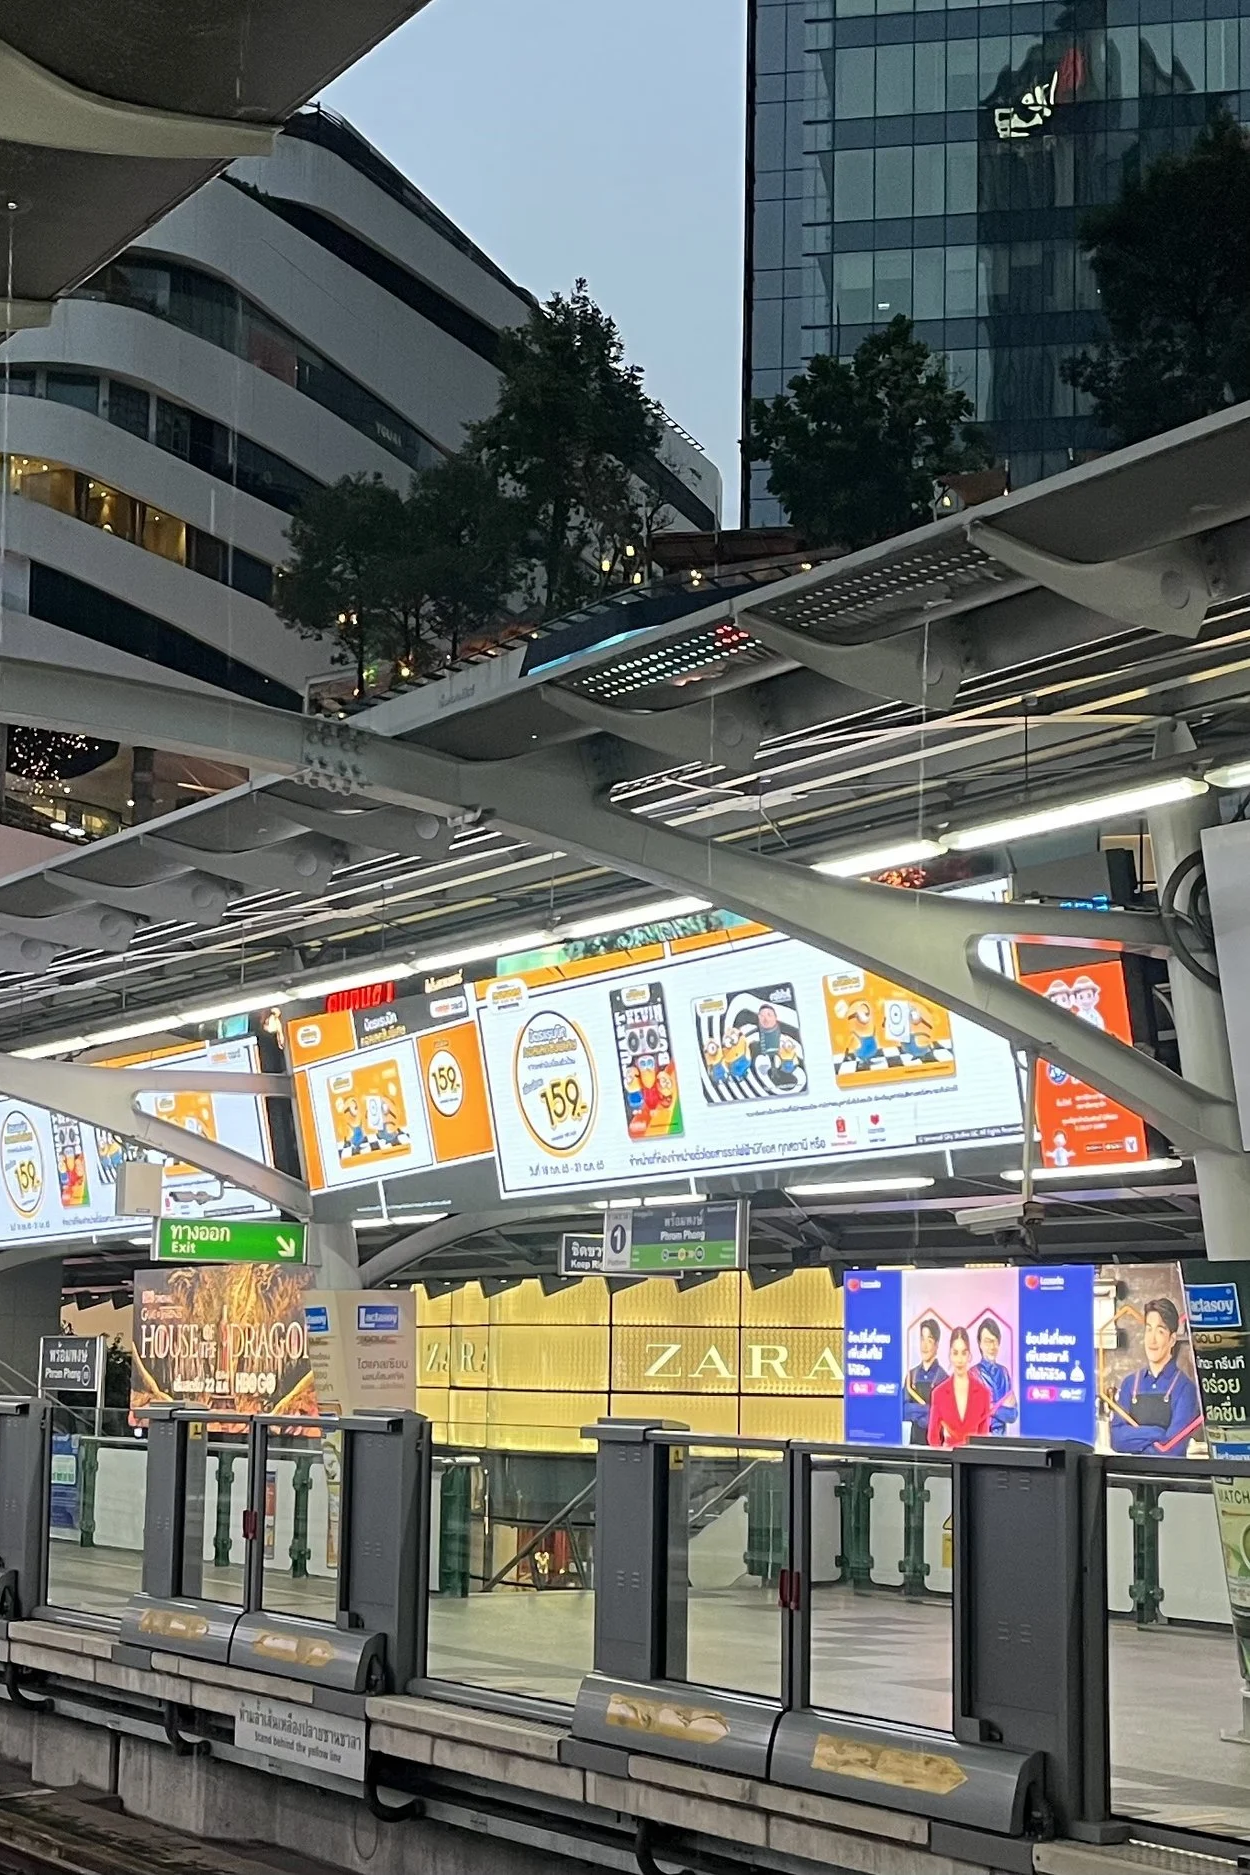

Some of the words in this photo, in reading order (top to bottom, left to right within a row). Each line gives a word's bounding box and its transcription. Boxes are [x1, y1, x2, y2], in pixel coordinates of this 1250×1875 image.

[170, 1223, 230, 1242] ทางออก
[613, 1226, 622, 1251] 1
[660, 1231, 682, 1241] Phrom
[683, 1230, 705, 1241] Phong
[171, 1242, 196, 1254] Exit
[141, 1325, 199, 1358] HOUSE
[203, 1325, 215, 1340] OF
[644, 1344, 845, 1380] ZARA
[1202, 1373, 1240, 1394] อร่อย
[1206, 1396, 1246, 1421] สดชื่น
[255, 1731, 271, 1744] Stand
[273, 1735, 294, 1750] behind
[296, 1741, 306, 1753] the
[308, 1746, 328, 1760] yellow
[330, 1751, 342, 1763] line
